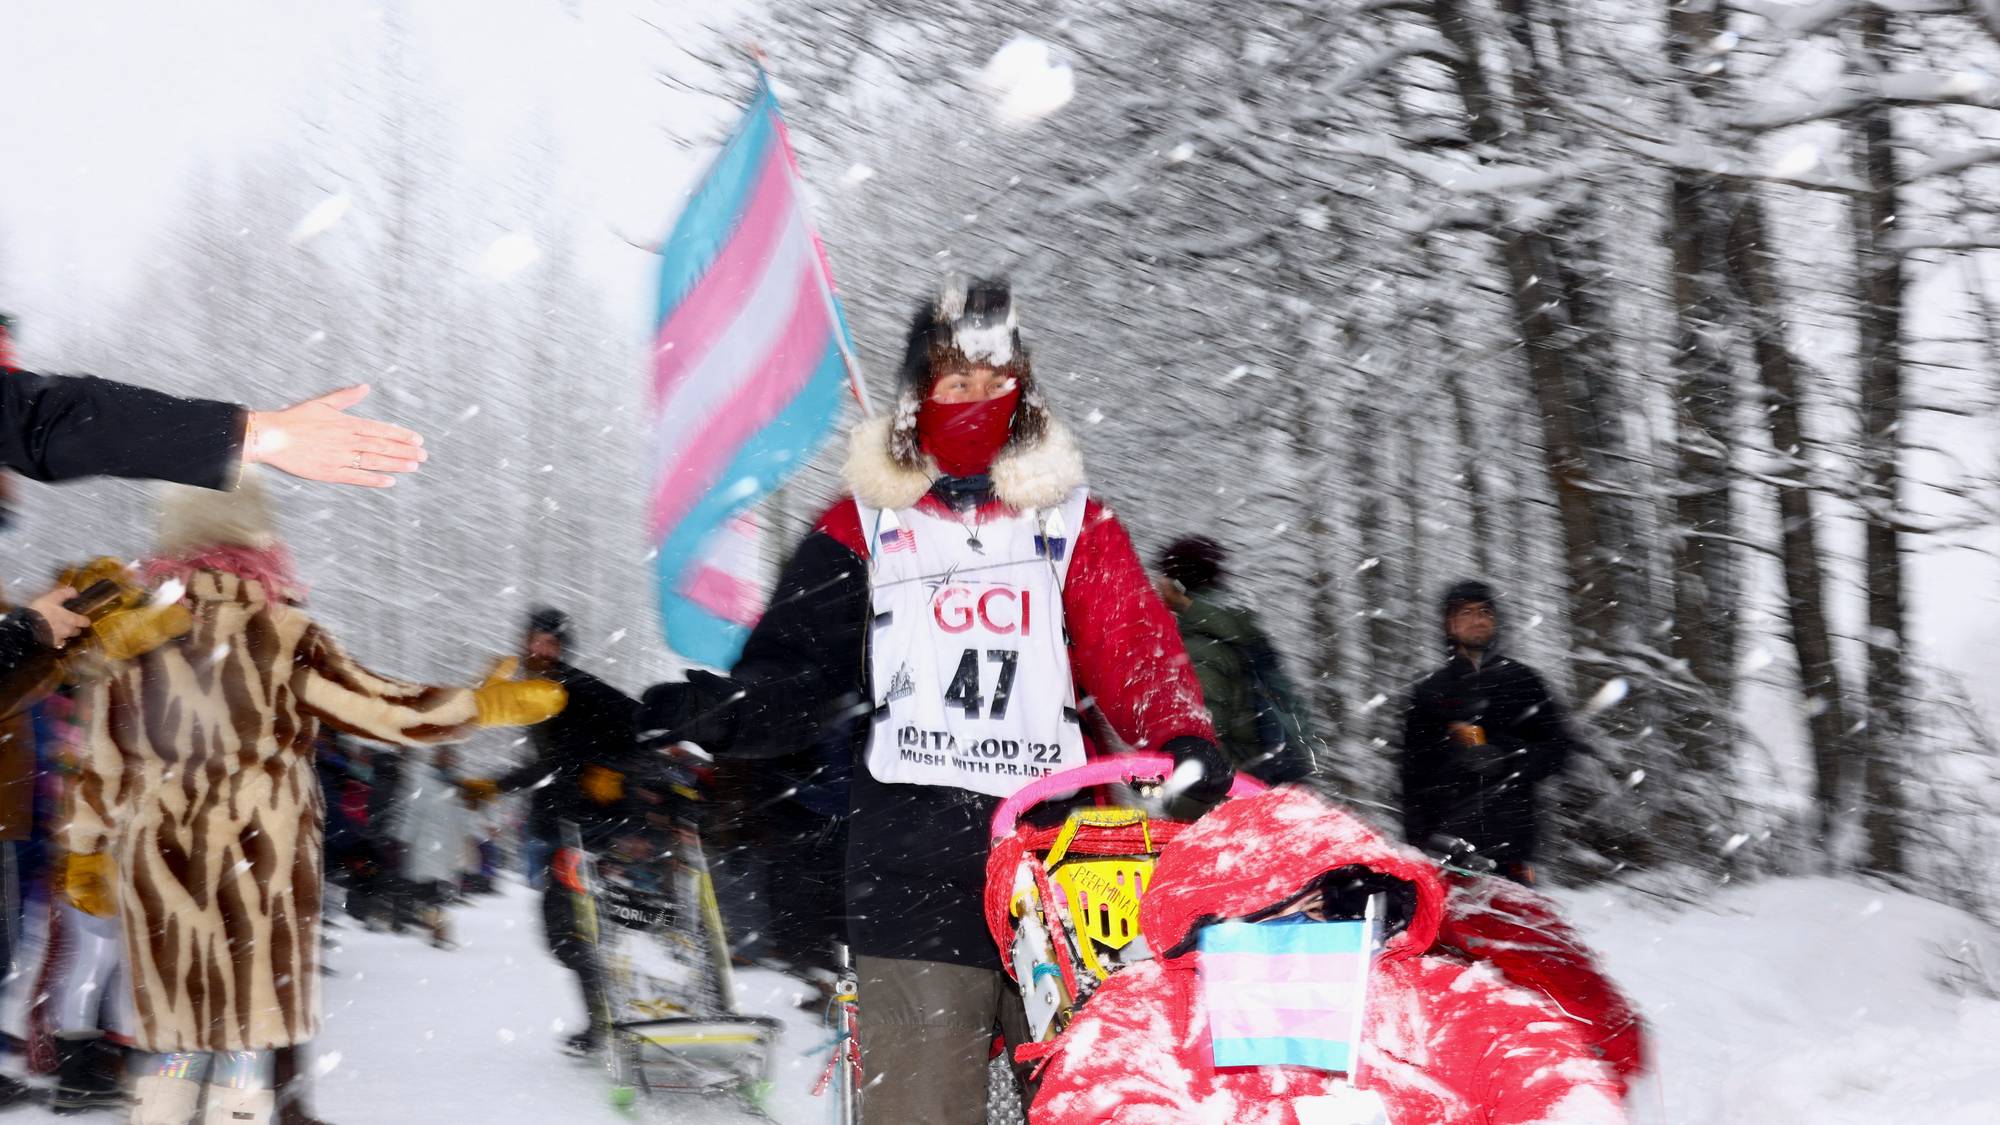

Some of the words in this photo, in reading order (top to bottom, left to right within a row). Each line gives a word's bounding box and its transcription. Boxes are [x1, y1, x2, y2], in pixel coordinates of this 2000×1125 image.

[933, 586, 1031, 637] GCI
[944, 648, 1019, 720] 47
[899, 749, 946, 767] MUSH
[951, 756, 990, 774] WITH
[1028, 743, 1062, 764] '22
